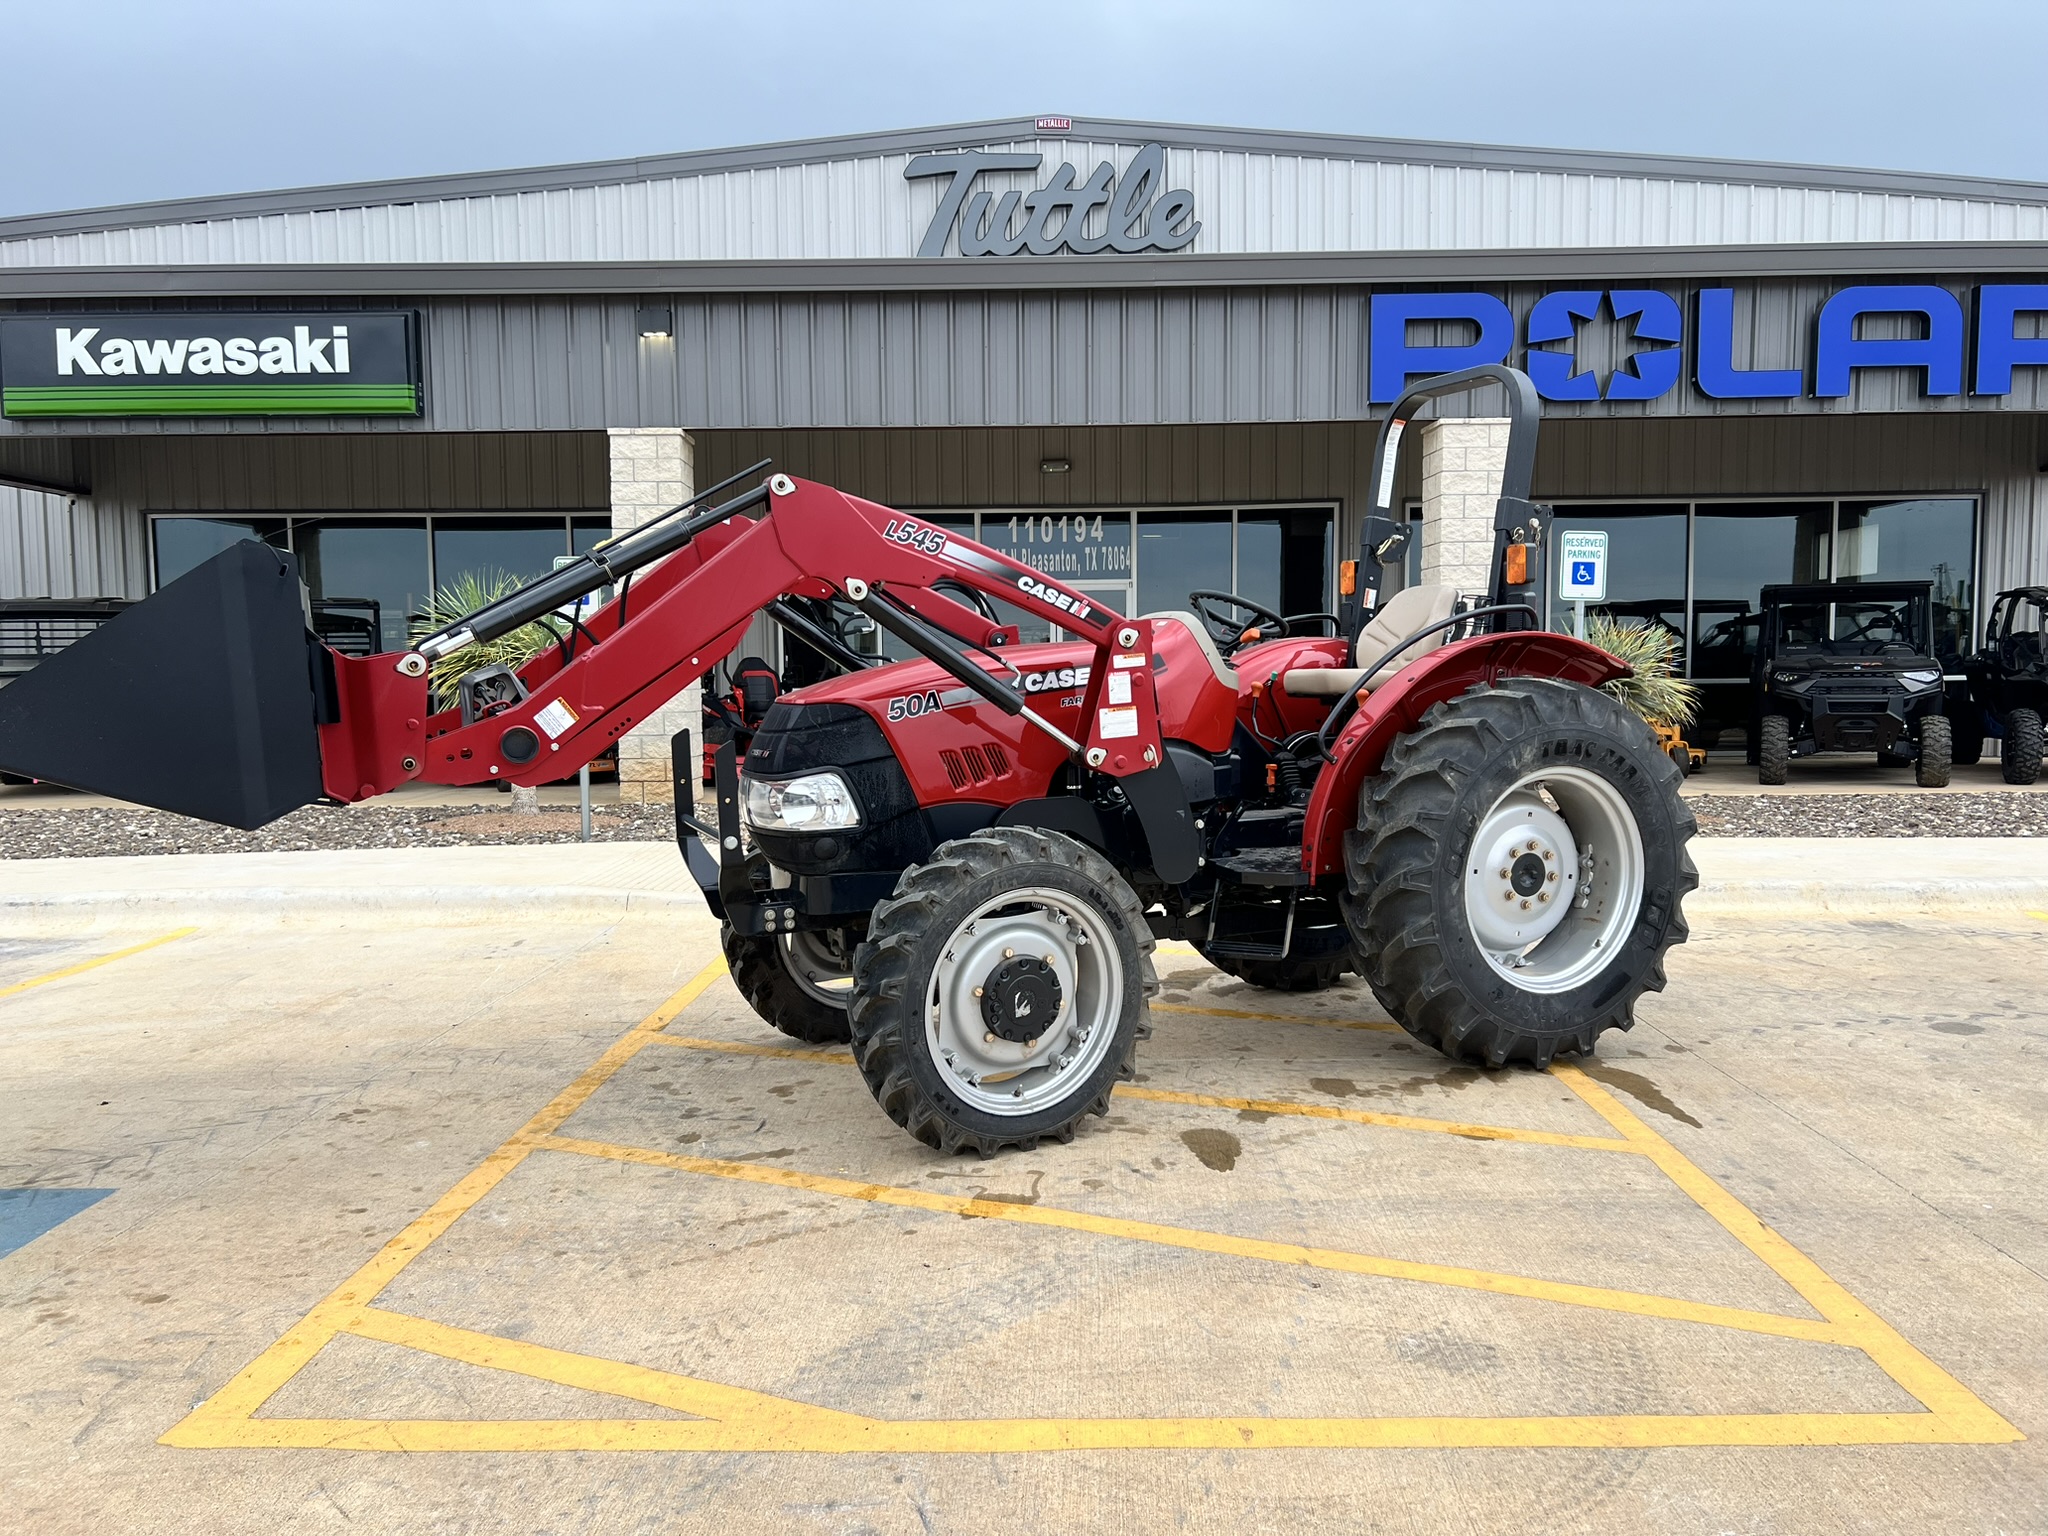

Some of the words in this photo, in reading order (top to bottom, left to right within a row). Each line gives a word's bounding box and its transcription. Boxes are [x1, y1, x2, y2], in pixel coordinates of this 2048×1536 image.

[1038, 119, 1068, 128] METALLIC
[903, 142, 1202, 257] Tuttle
[55, 326, 351, 376] Kawasaki
[883, 519, 947, 555] L545
[1008, 515, 1104, 543] 110194
[1565, 538, 1604, 548] RESERVED
[1021, 548, 1081, 576] Pleasanton,
[1085, 546, 1098, 571] TX
[1101, 545, 1131, 571] 78064
[1567, 549, 1601, 559] PARKING
[1017, 575, 1074, 611] CASE
[1025, 667, 1091, 692] CASE
[887, 690, 943, 722] 50A
[1061, 695, 1084, 708] FAR
